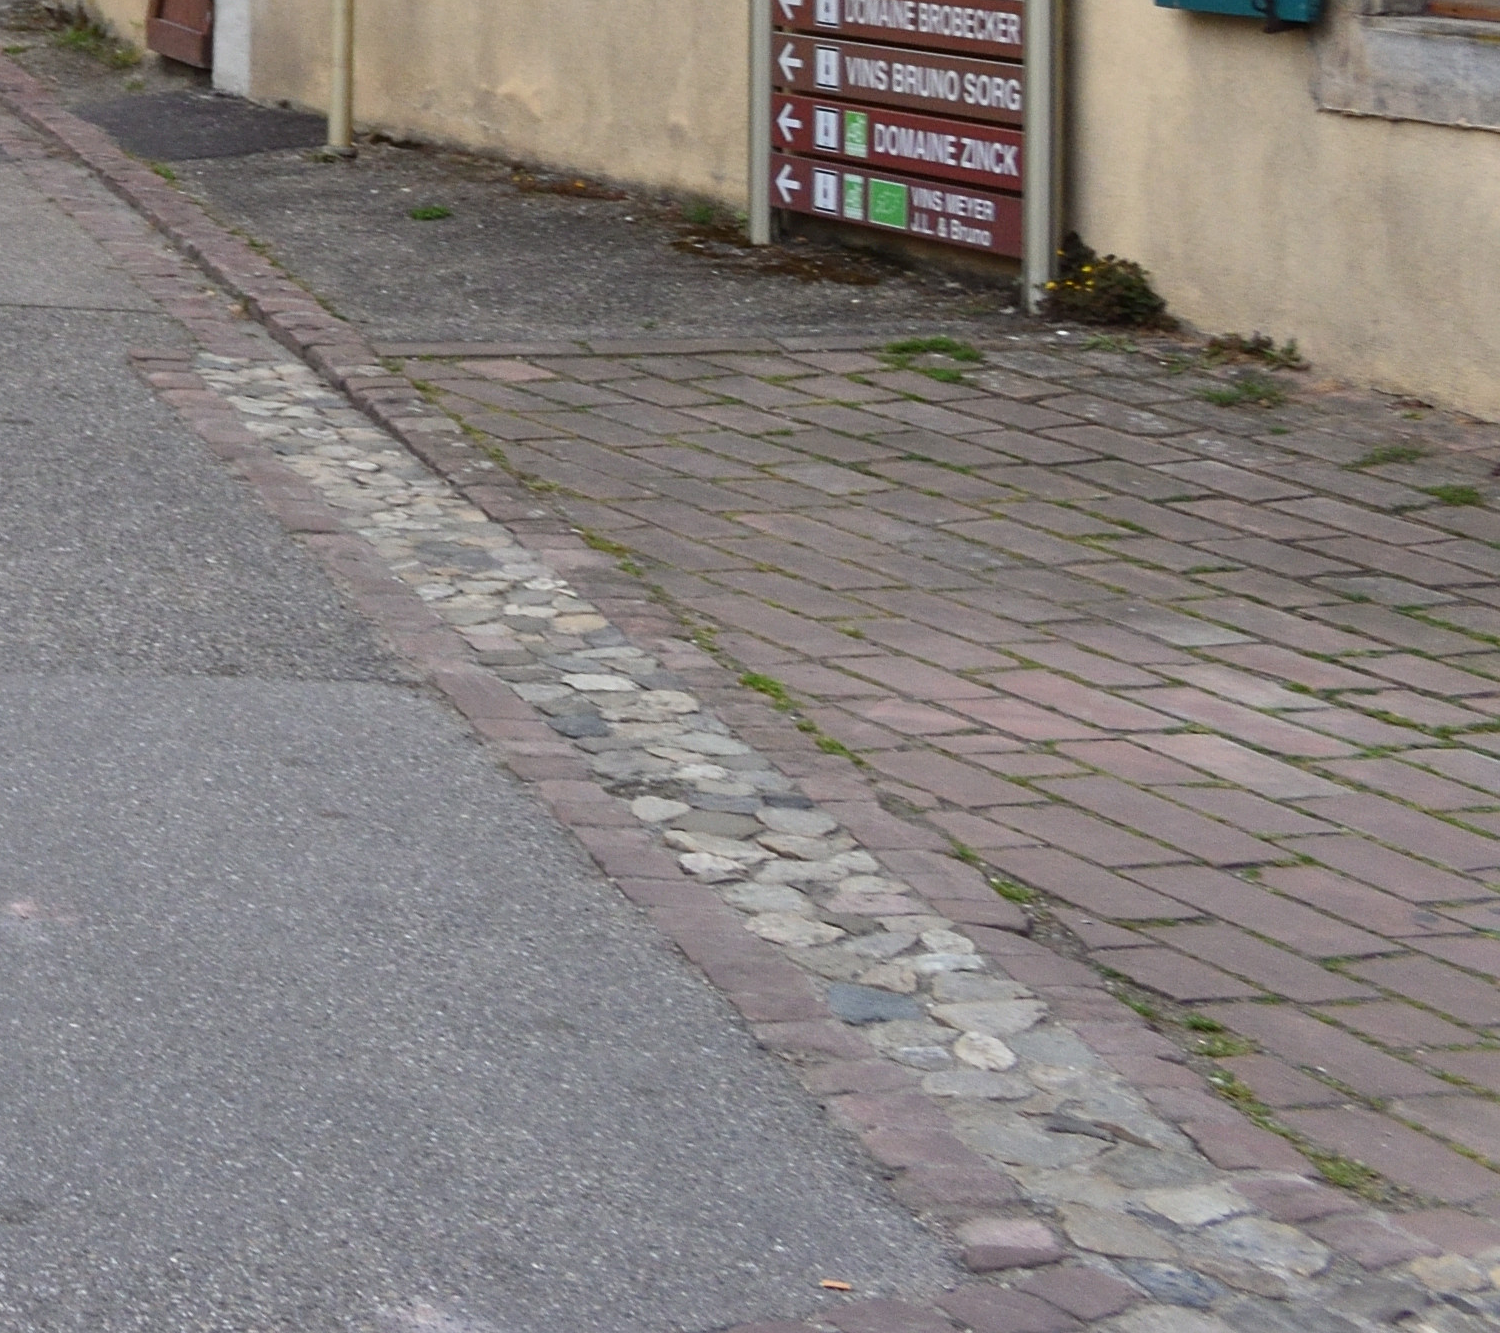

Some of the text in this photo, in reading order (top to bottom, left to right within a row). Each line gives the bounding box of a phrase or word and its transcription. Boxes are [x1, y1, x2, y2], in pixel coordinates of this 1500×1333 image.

[918, 2, 1021, 44] BROBECKER
[845, 56, 1021, 110] VINS BRUNO SORG
[873, 123, 958, 166] DOMAINE
[960, 137, 1019, 176] ZINCK
[911, 187, 995, 221] VINS MEYER
[950, 219, 991, 246] Bruno
